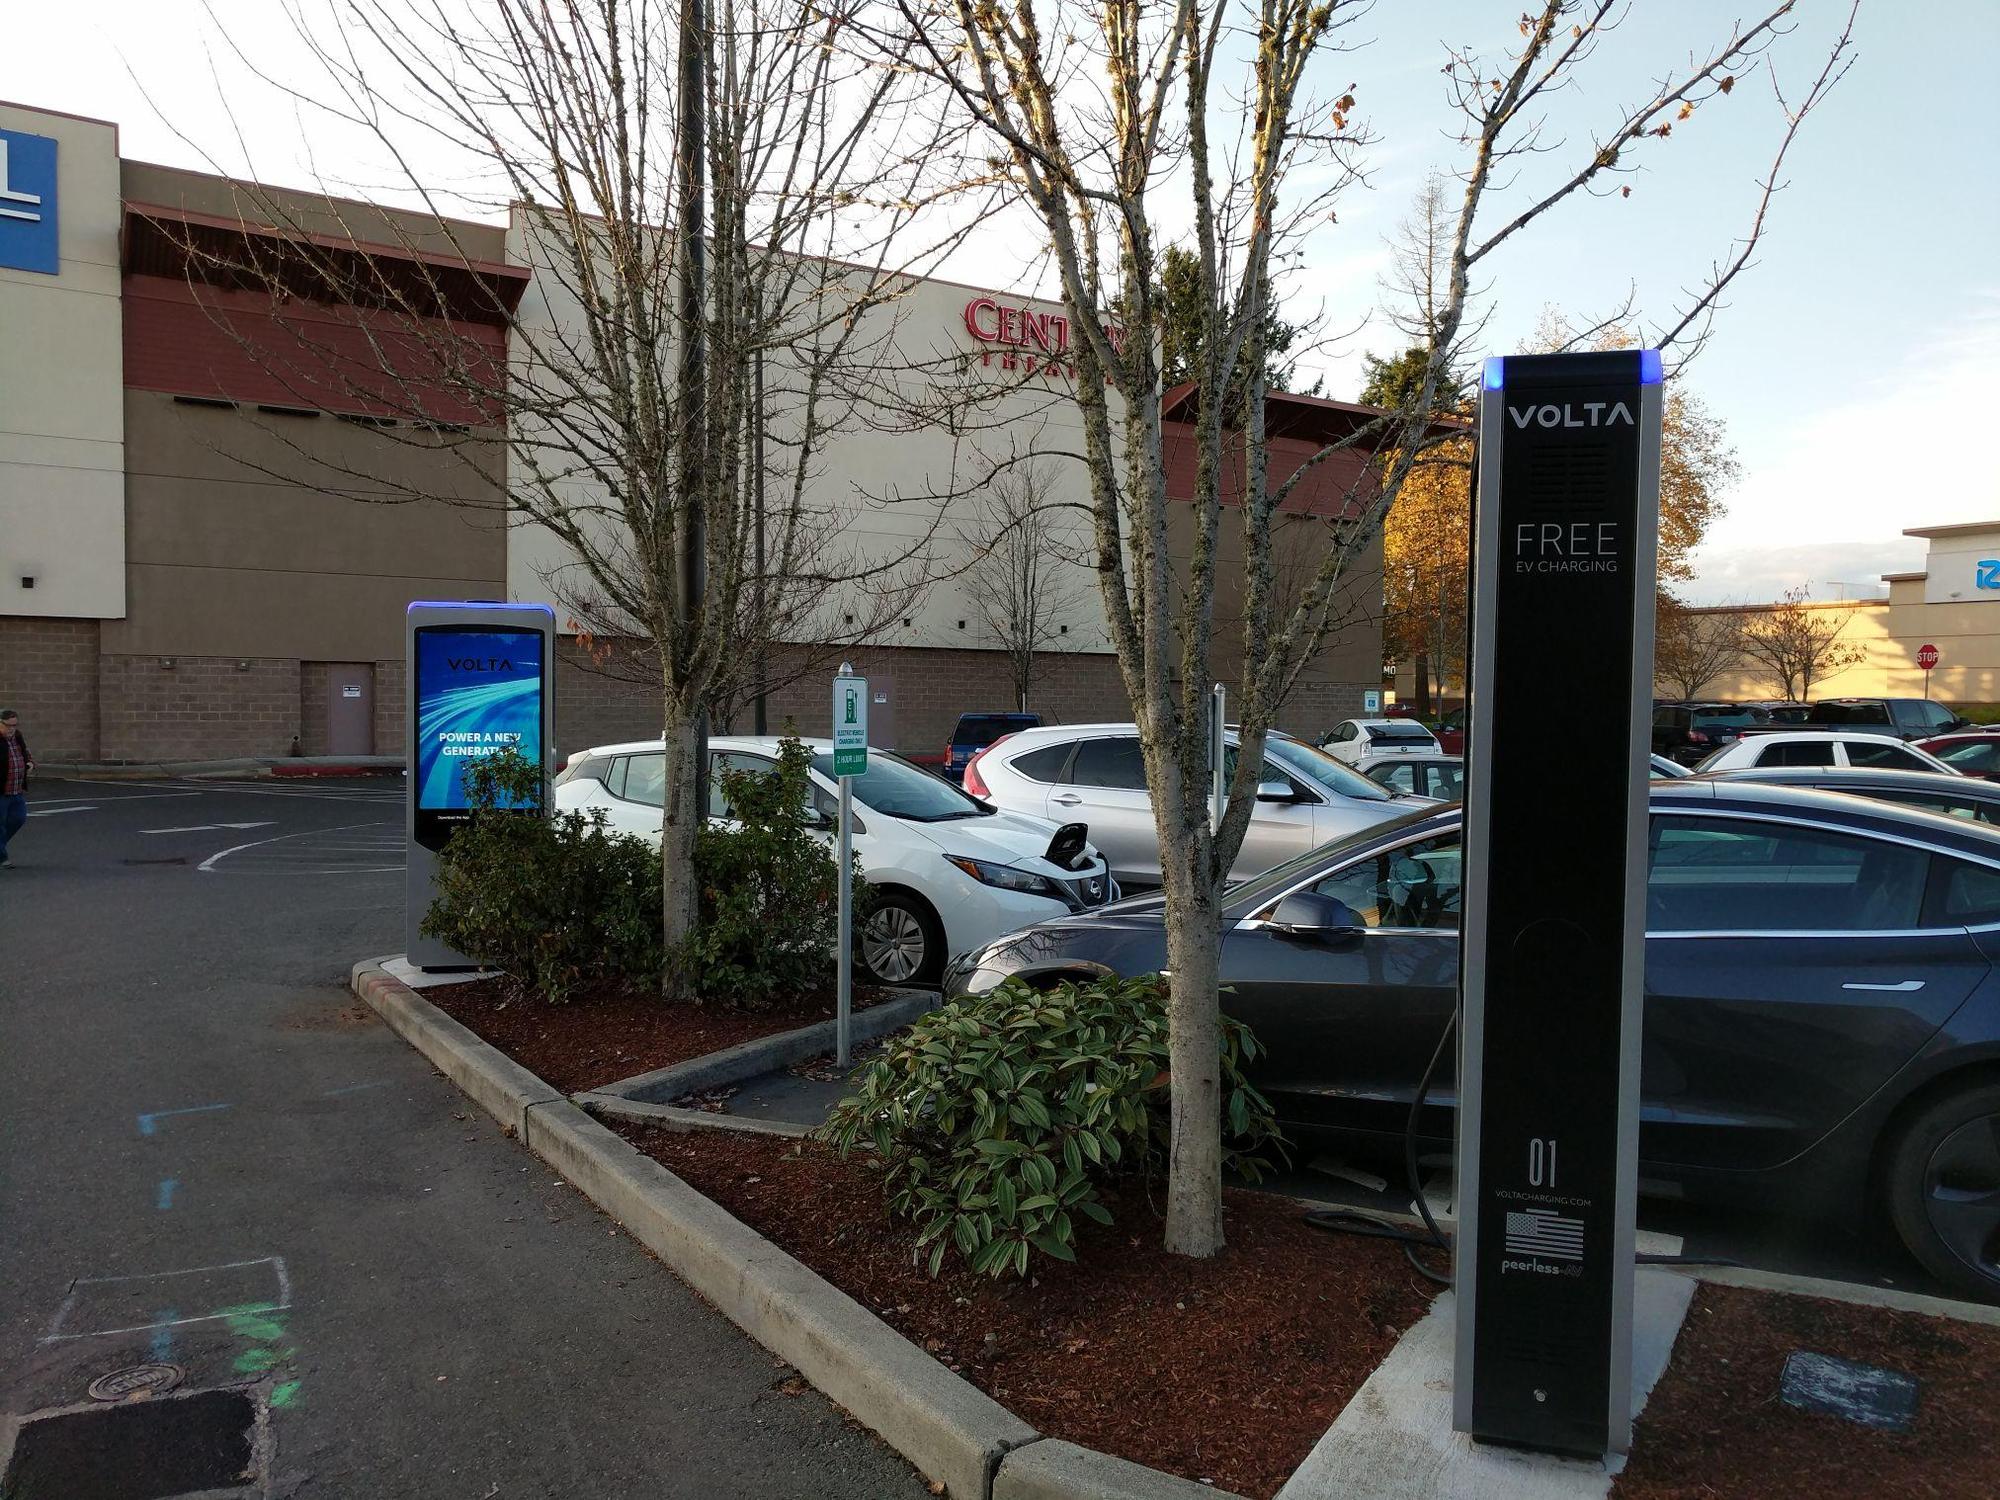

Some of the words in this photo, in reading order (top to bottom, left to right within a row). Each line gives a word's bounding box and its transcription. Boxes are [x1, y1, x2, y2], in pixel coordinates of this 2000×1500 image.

[1508, 402, 1635, 429] VOLTA
[1517, 522, 1618, 556] FREE
[1516, 561, 1534, 573] EV
[1537, 560, 1618, 573] CHARGING
[1917, 652, 1939, 662] STOP
[447, 657, 513, 671] VOLTA
[439, 732, 480, 742] POWER
[484, 732, 491, 742] A
[495, 732, 521, 742] NEW
[443, 746, 517, 756] GENERATI
[841, 755, 852, 764] HOUR
[1530, 1138, 1556, 1188] 01
[1496, 1190, 1591, 1206] VOLTACHARGING.COM
